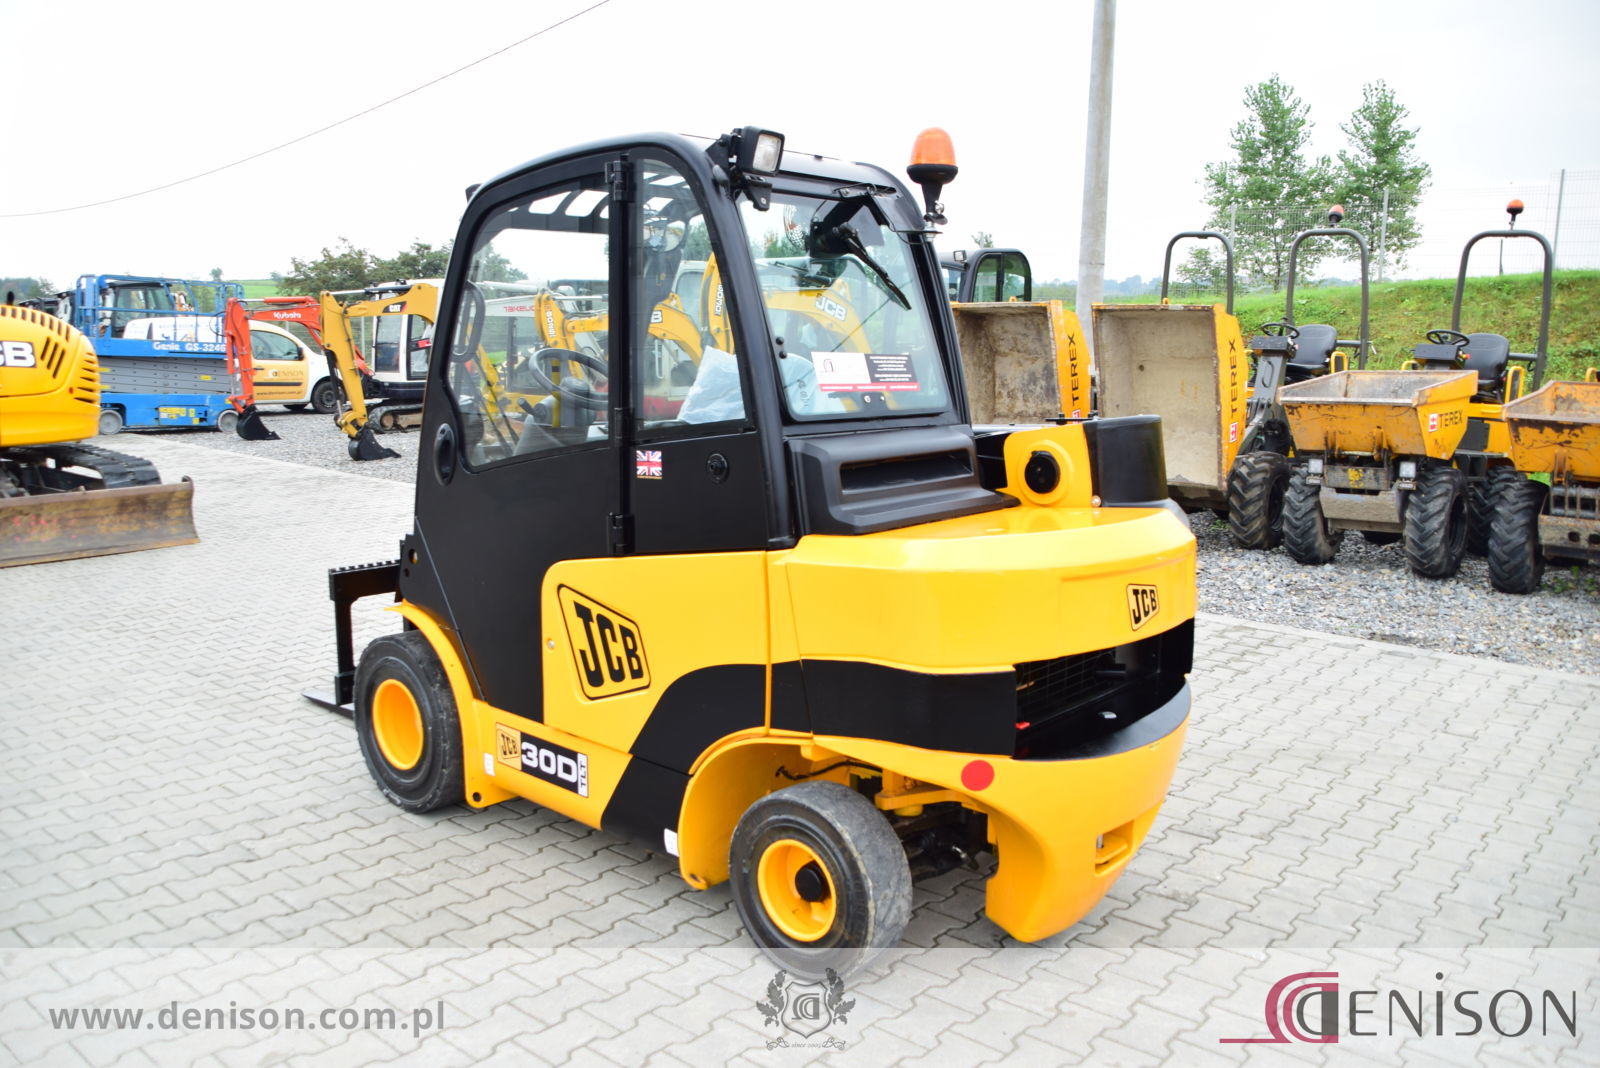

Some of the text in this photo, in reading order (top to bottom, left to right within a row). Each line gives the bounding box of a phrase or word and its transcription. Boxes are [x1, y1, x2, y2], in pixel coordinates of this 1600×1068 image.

[273, 311, 302, 320] Kubota
[389, 304, 401, 312] CAT
[816, 297, 846, 321] JCB
[153, 341, 180, 351] Genie
[1068, 332, 1080, 407] TEREX
[1228, 339, 1238, 419] TEREX
[1438, 409, 1463, 428] TEREX
[1132, 588, 1157, 624] JCB
[573, 600, 644, 687] JCB
[501, 733, 578, 783] JCB 30D
